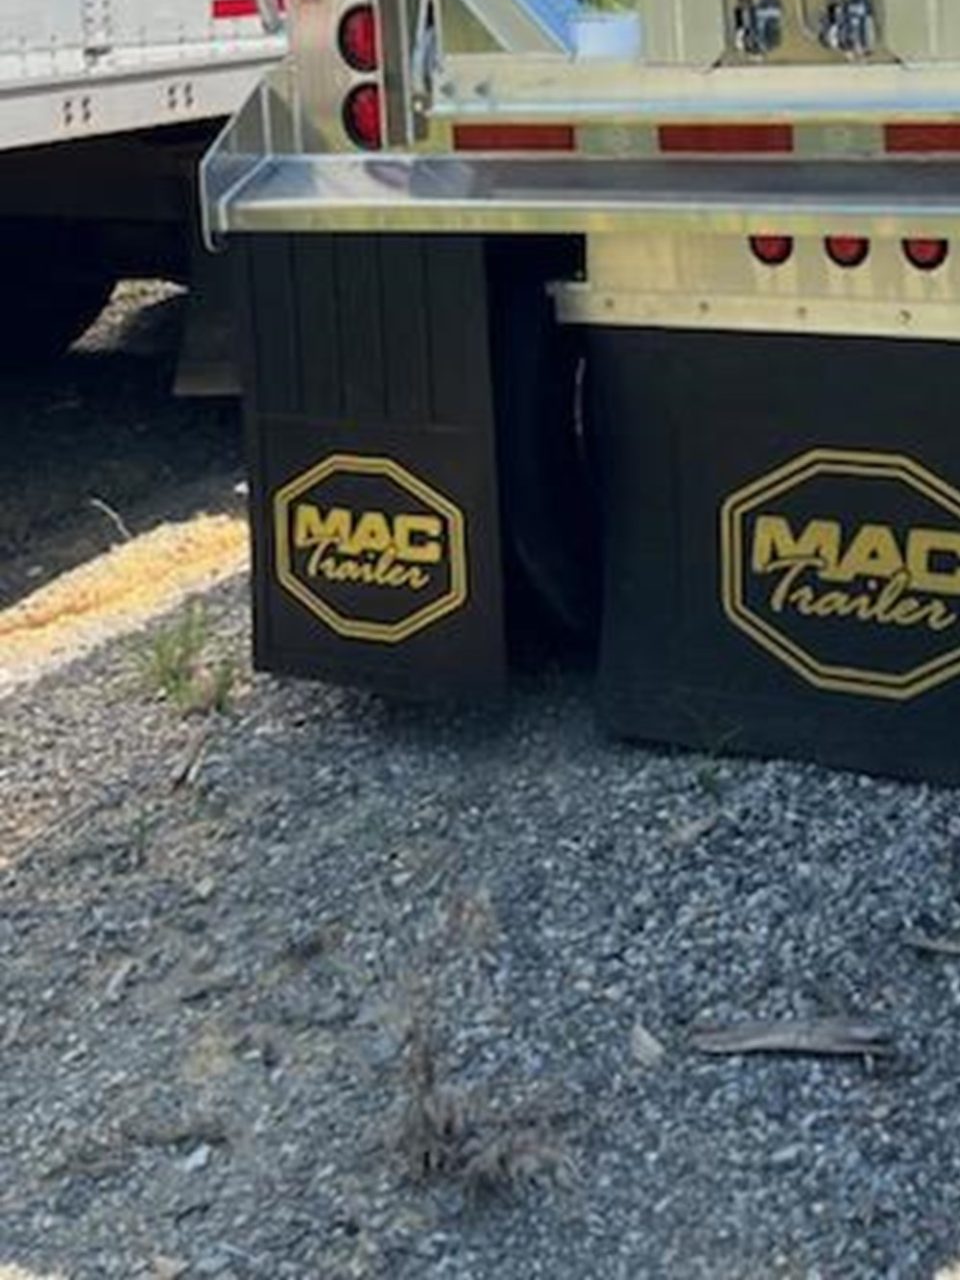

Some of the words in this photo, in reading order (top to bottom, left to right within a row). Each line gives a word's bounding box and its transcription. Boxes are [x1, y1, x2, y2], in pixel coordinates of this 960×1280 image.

[295, 504, 443, 563] MAC
[300, 538, 430, 588] Trailer
[764, 557, 957, 630] Trailer
